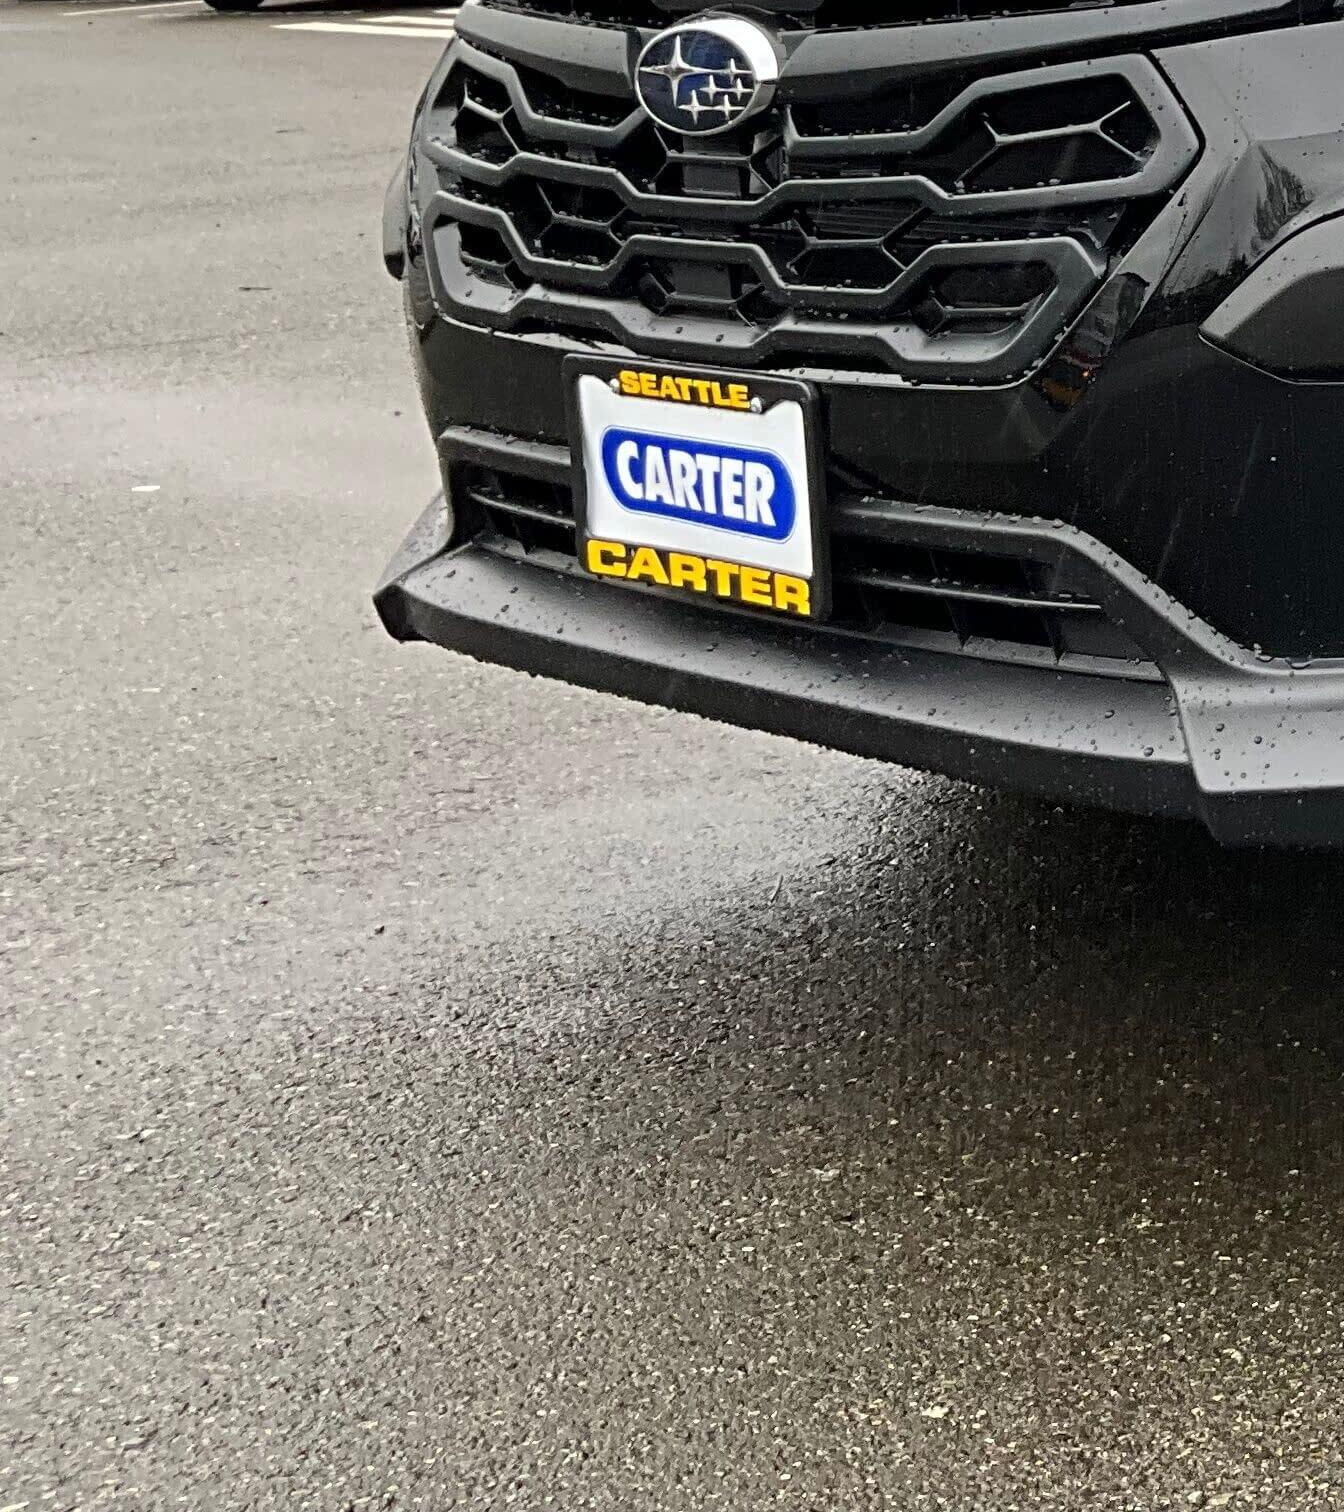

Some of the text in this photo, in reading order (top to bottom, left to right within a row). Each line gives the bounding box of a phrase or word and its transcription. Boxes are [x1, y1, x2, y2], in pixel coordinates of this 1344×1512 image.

[619, 370, 750, 409] SEATTLE
[616, 440, 776, 527] CARTER
[587, 539, 810, 615] CARTER
